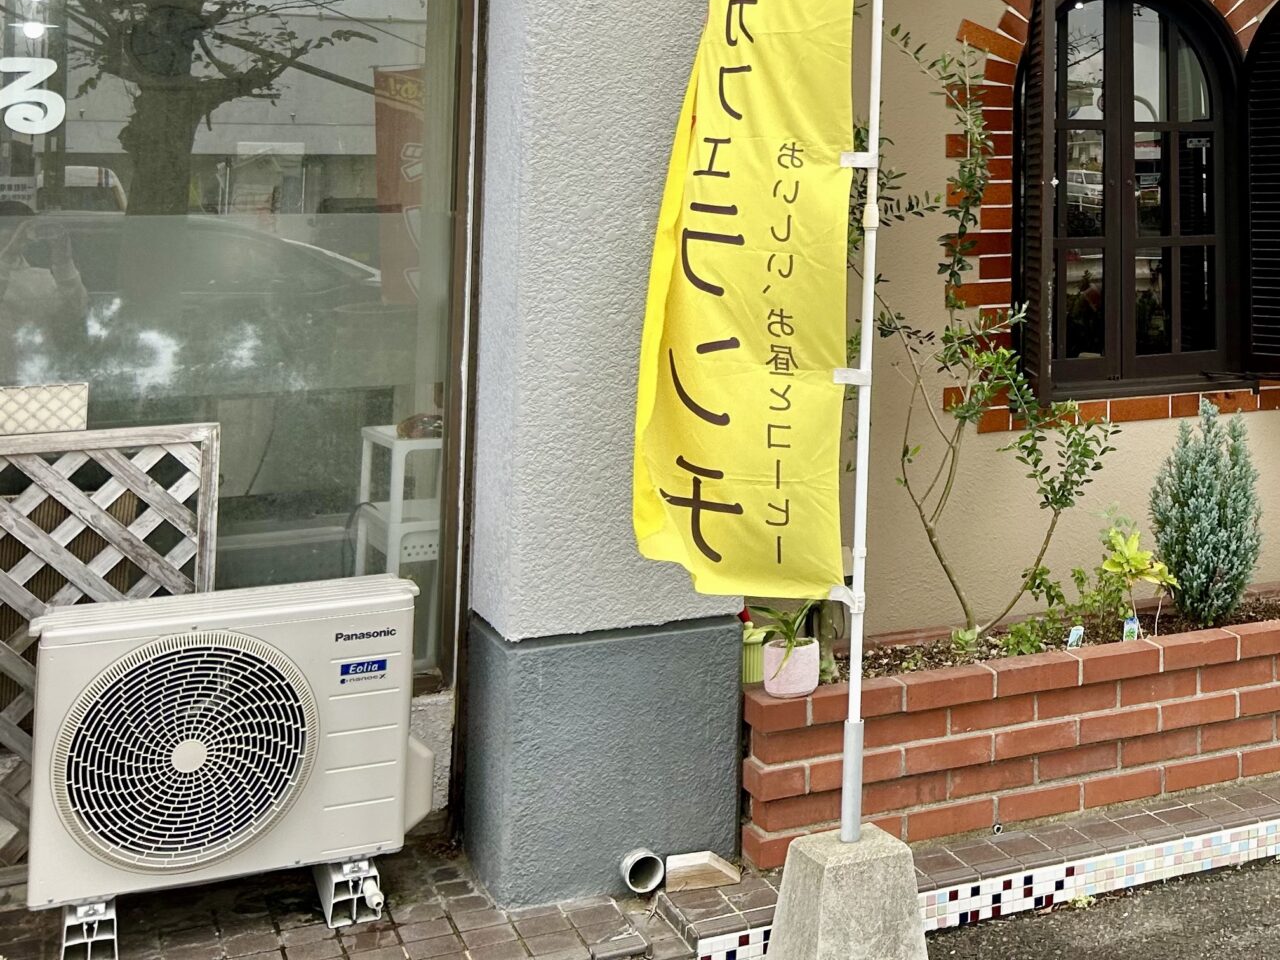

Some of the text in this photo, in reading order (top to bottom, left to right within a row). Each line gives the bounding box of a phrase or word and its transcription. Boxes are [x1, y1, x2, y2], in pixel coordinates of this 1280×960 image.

[0, 57, 66, 135] る
[335, 627, 397, 643] Panasonic
[348, 662, 379, 674] Eolia
